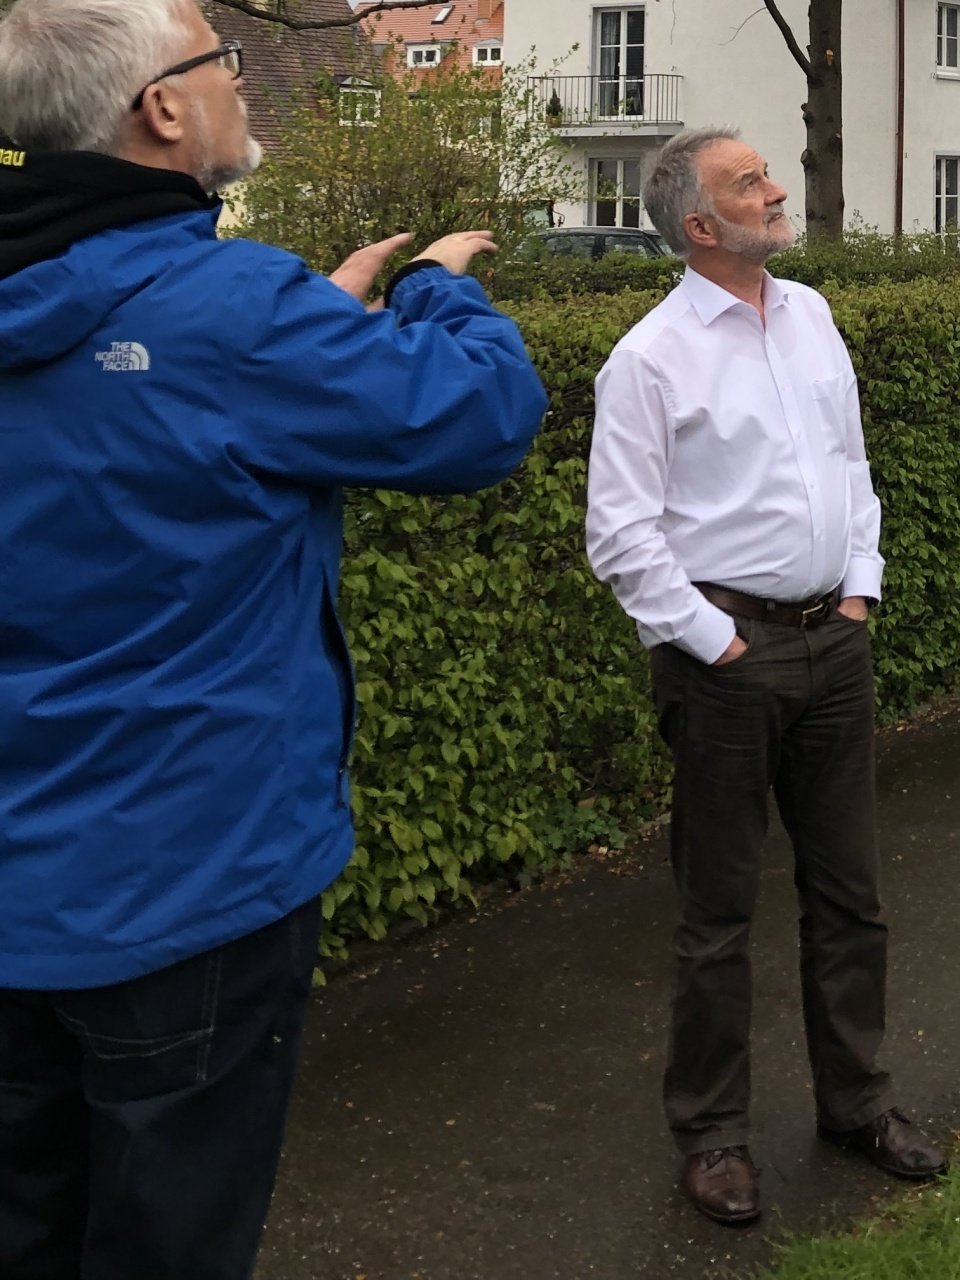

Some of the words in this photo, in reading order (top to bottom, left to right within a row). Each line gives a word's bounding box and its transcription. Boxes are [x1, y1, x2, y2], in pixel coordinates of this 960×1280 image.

[110, 341, 130, 351] THE
[95, 351, 129, 361] NORTH
[102, 361, 129, 371] FACE
